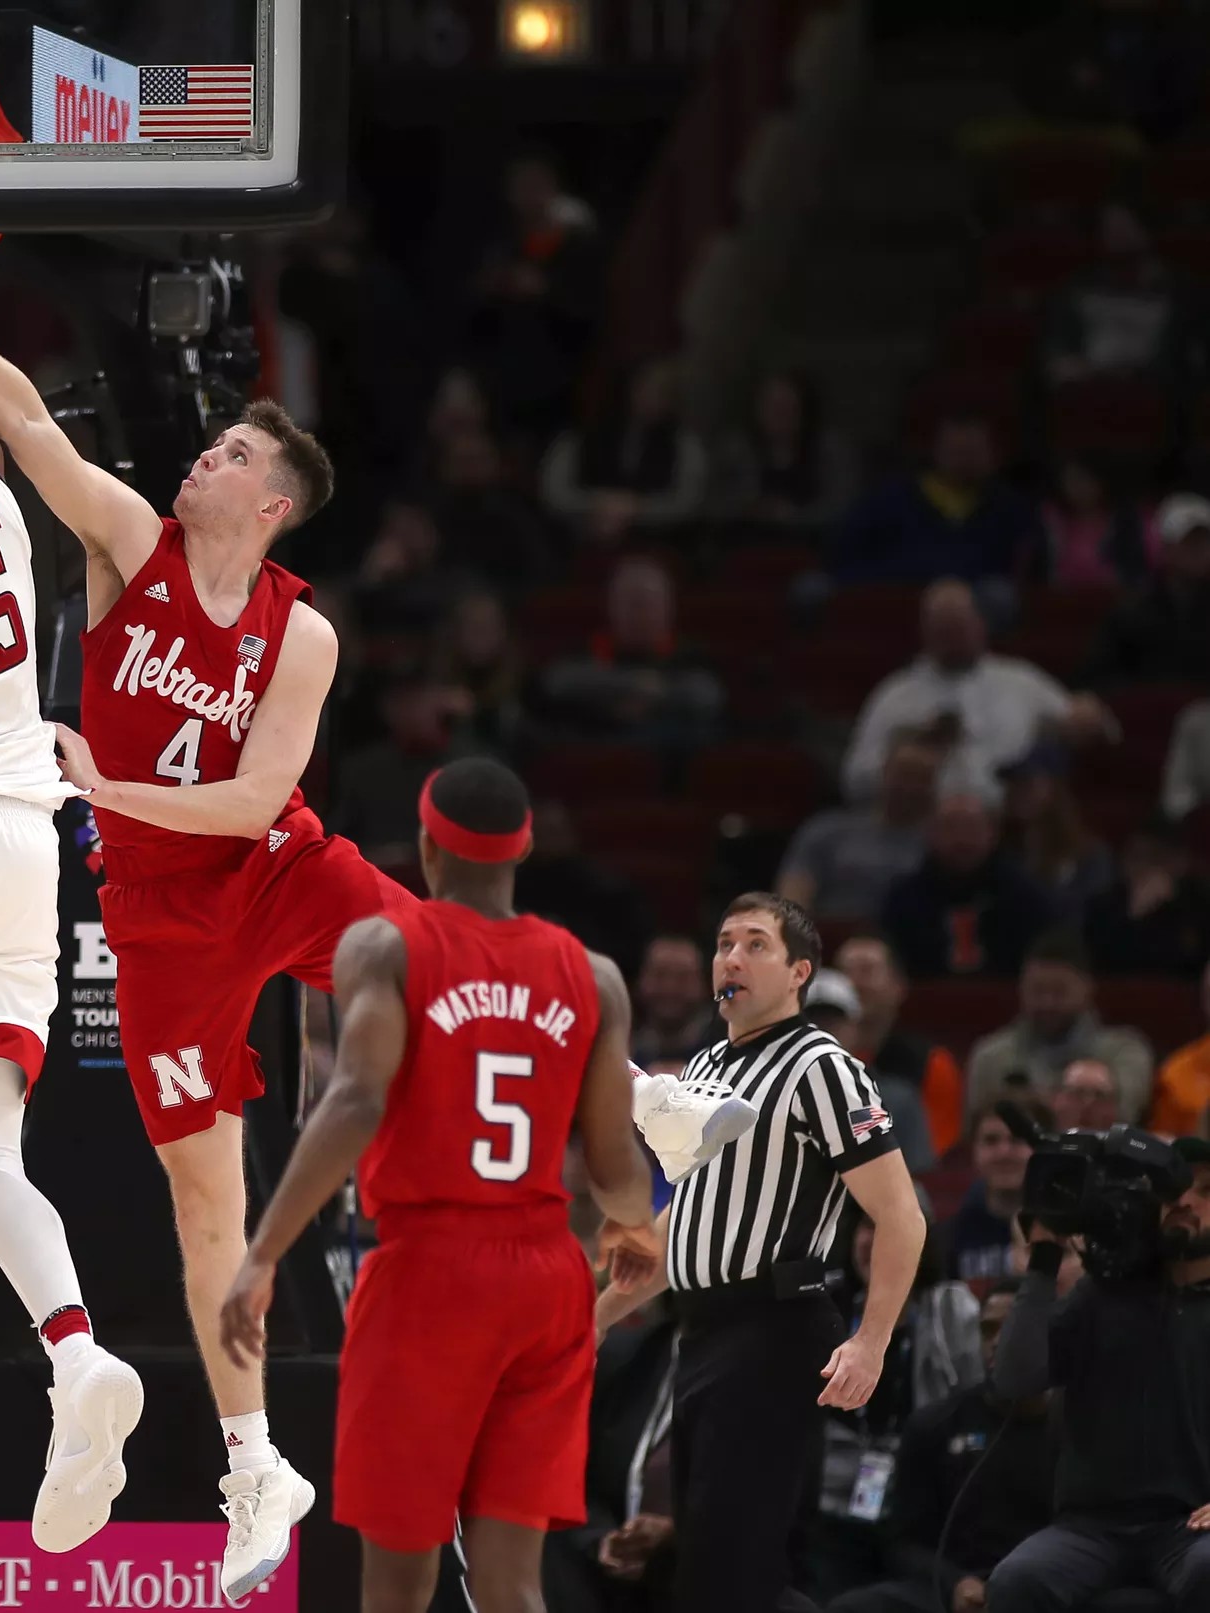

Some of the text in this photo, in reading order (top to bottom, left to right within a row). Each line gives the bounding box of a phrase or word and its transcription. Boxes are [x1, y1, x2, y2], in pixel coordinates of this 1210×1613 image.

[156, 718, 204, 786] 4
[71, 1031, 122, 1048] CHIC
[425, 980, 576, 1048] WATSON JR.
[149, 1045, 214, 1109] N
[471, 1051, 533, 1182] 5
